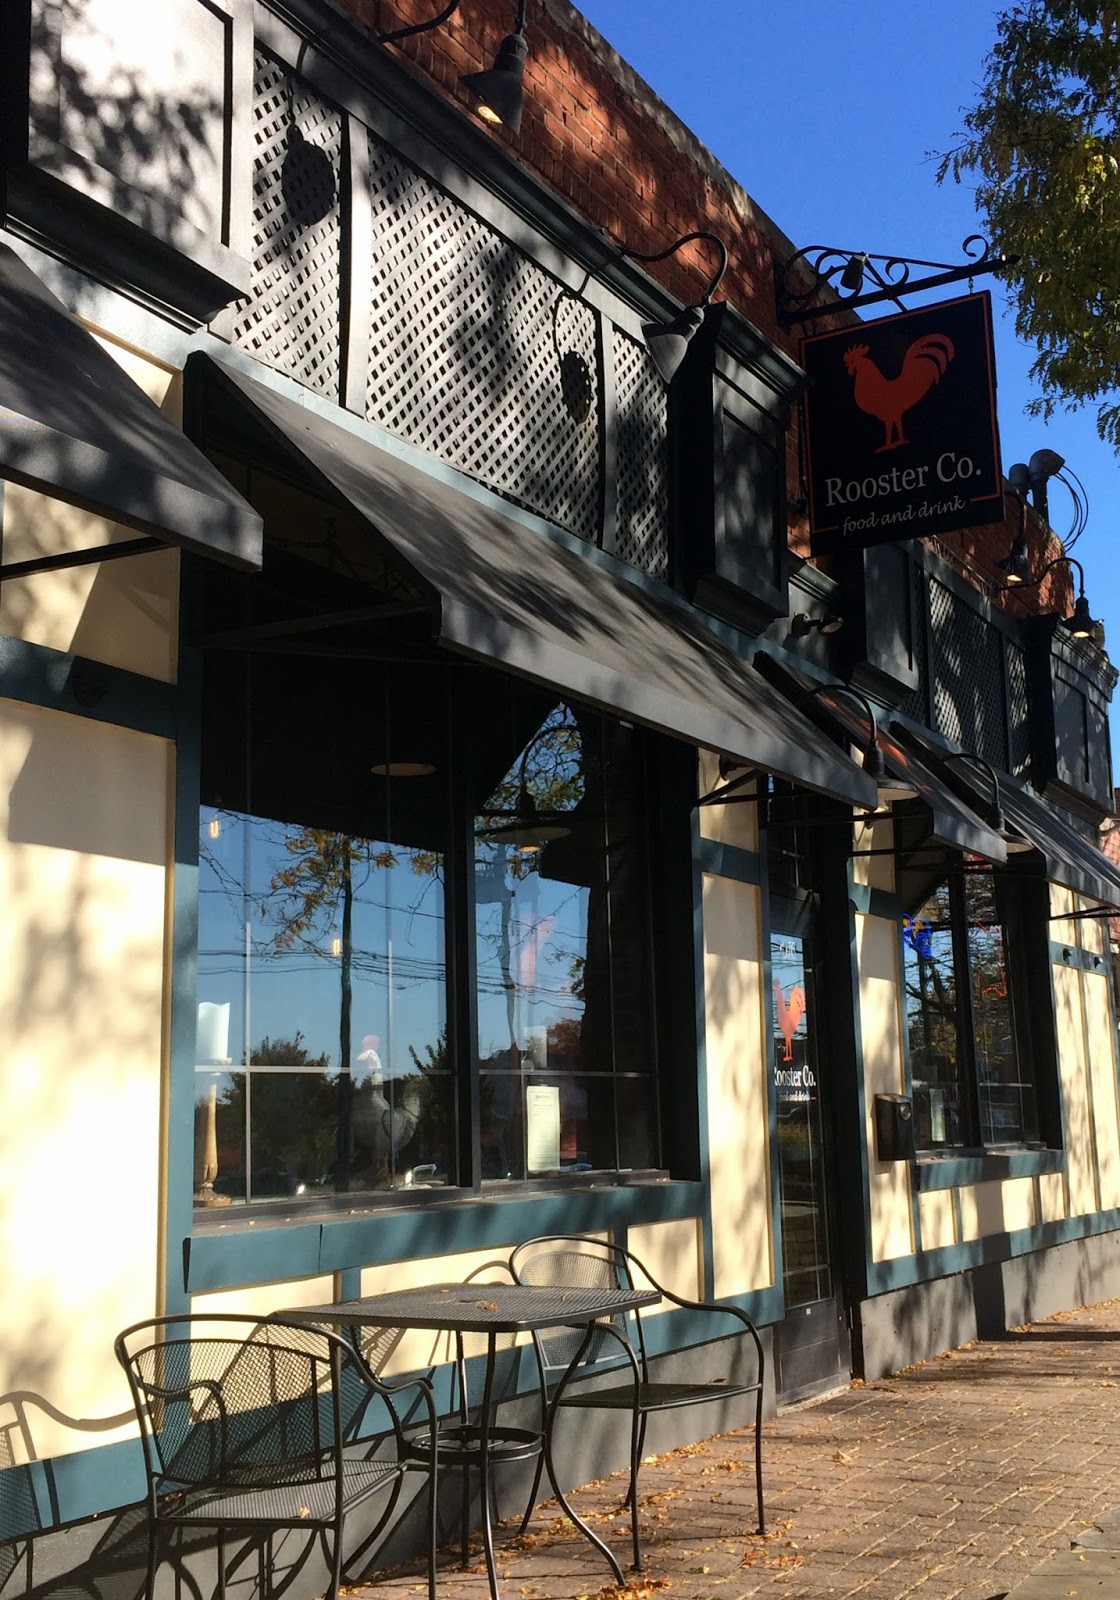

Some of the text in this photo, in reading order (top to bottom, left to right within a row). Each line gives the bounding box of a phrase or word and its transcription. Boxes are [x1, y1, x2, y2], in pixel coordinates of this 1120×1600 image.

[825, 452, 982, 507] Rooster Co.
[843, 495, 967, 536] food and drink
[803, 1065, 816, 1087] Co.
